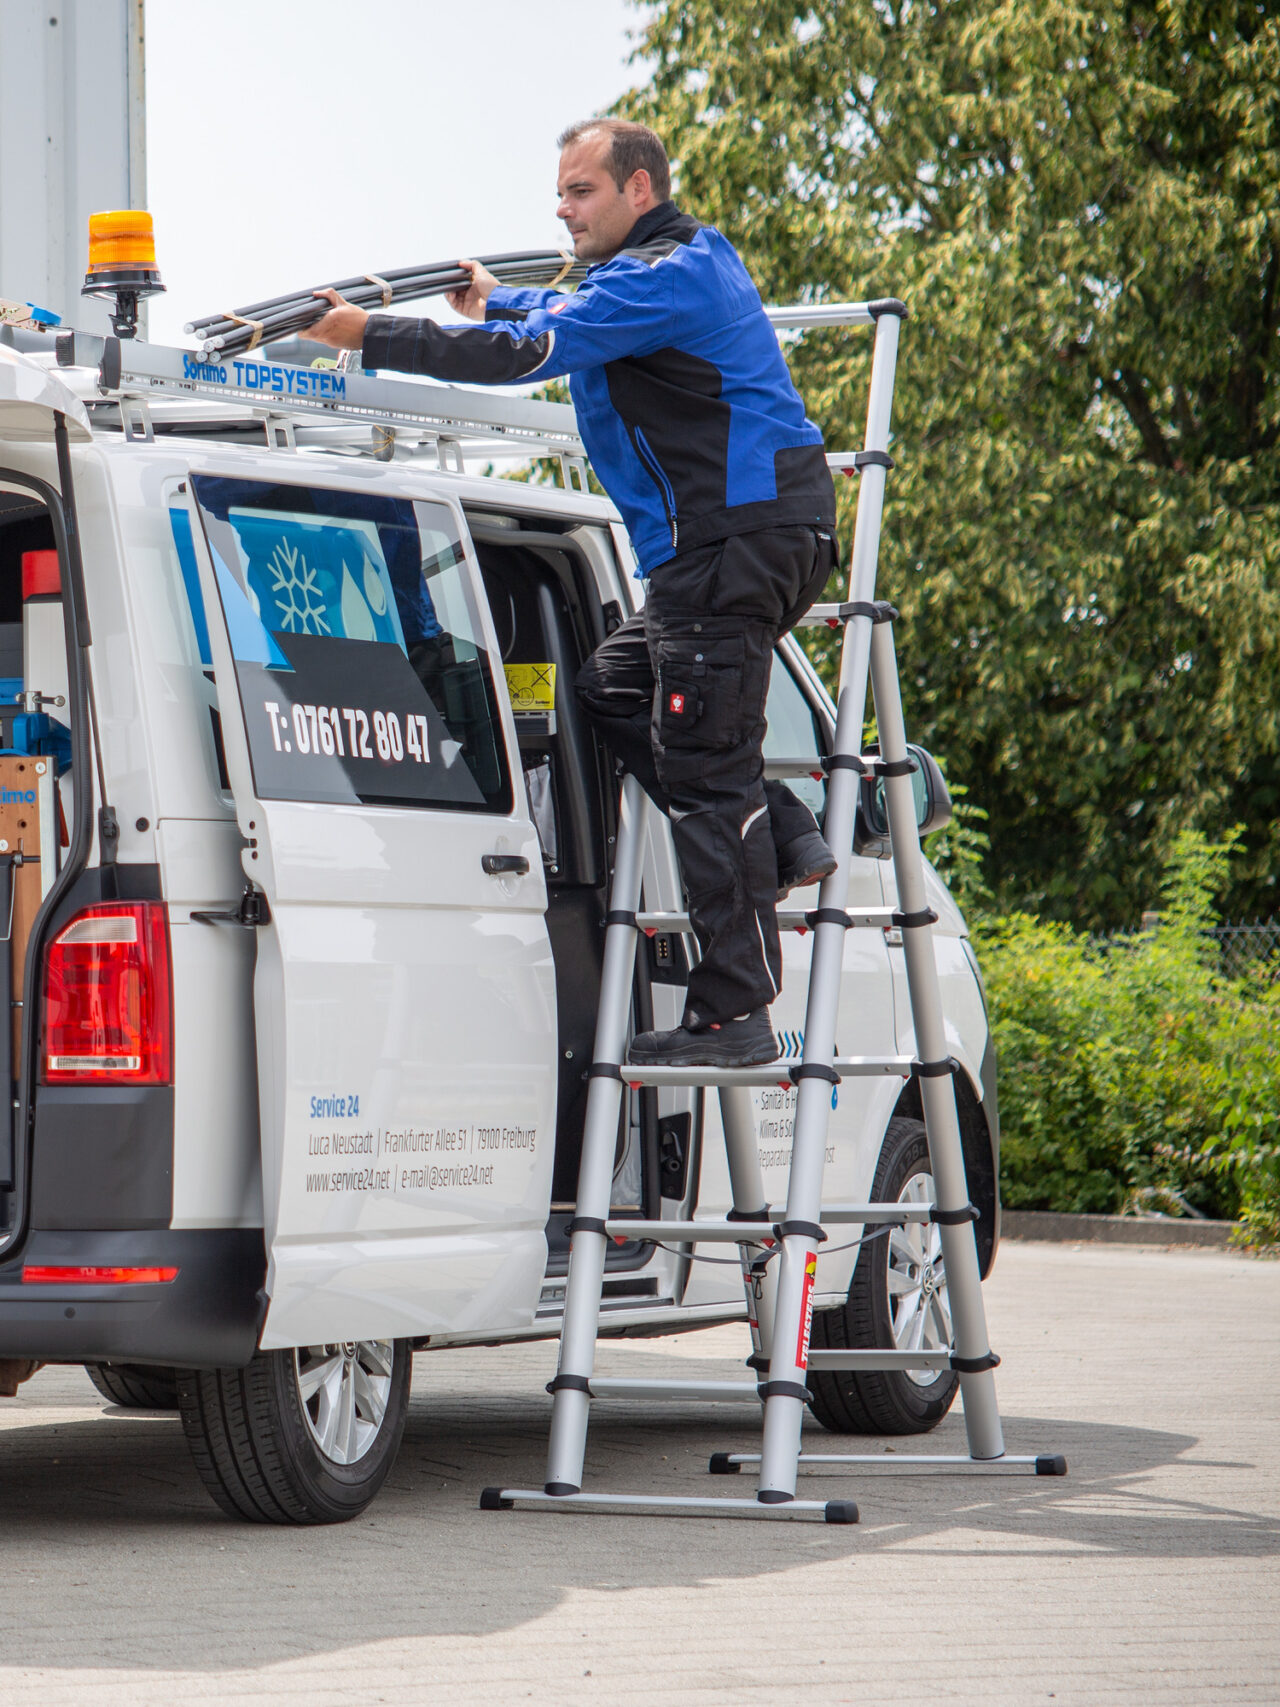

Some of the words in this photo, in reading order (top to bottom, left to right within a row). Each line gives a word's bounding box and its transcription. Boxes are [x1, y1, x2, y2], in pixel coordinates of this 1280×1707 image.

[183, 354, 227, 384] Sortimo
[233, 361, 346, 400] TOPSYSTEM
[264, 702, 292, 753] T:
[292, 703, 345, 757] 0761
[342, 708, 374, 759] 72
[372, 710, 404, 762] 80
[406, 713, 431, 763] 47
[310, 1093, 346, 1118] Service
[347, 1095, 359, 1117] 24
[308, 1134, 329, 1155] Luca
[332, 1130, 373, 1155] Neustadt
[384, 1128, 434, 1153] Frankfurter
[435, 1128, 456, 1151] Allee
[458, 1129, 467, 1150] 51
[477, 1127, 500, 1150] 79100
[502, 1126, 536, 1152] Freiburg
[306, 1168, 390, 1192] www.service24.net
[401, 1163, 494, 1190] e-mail@service24.net
